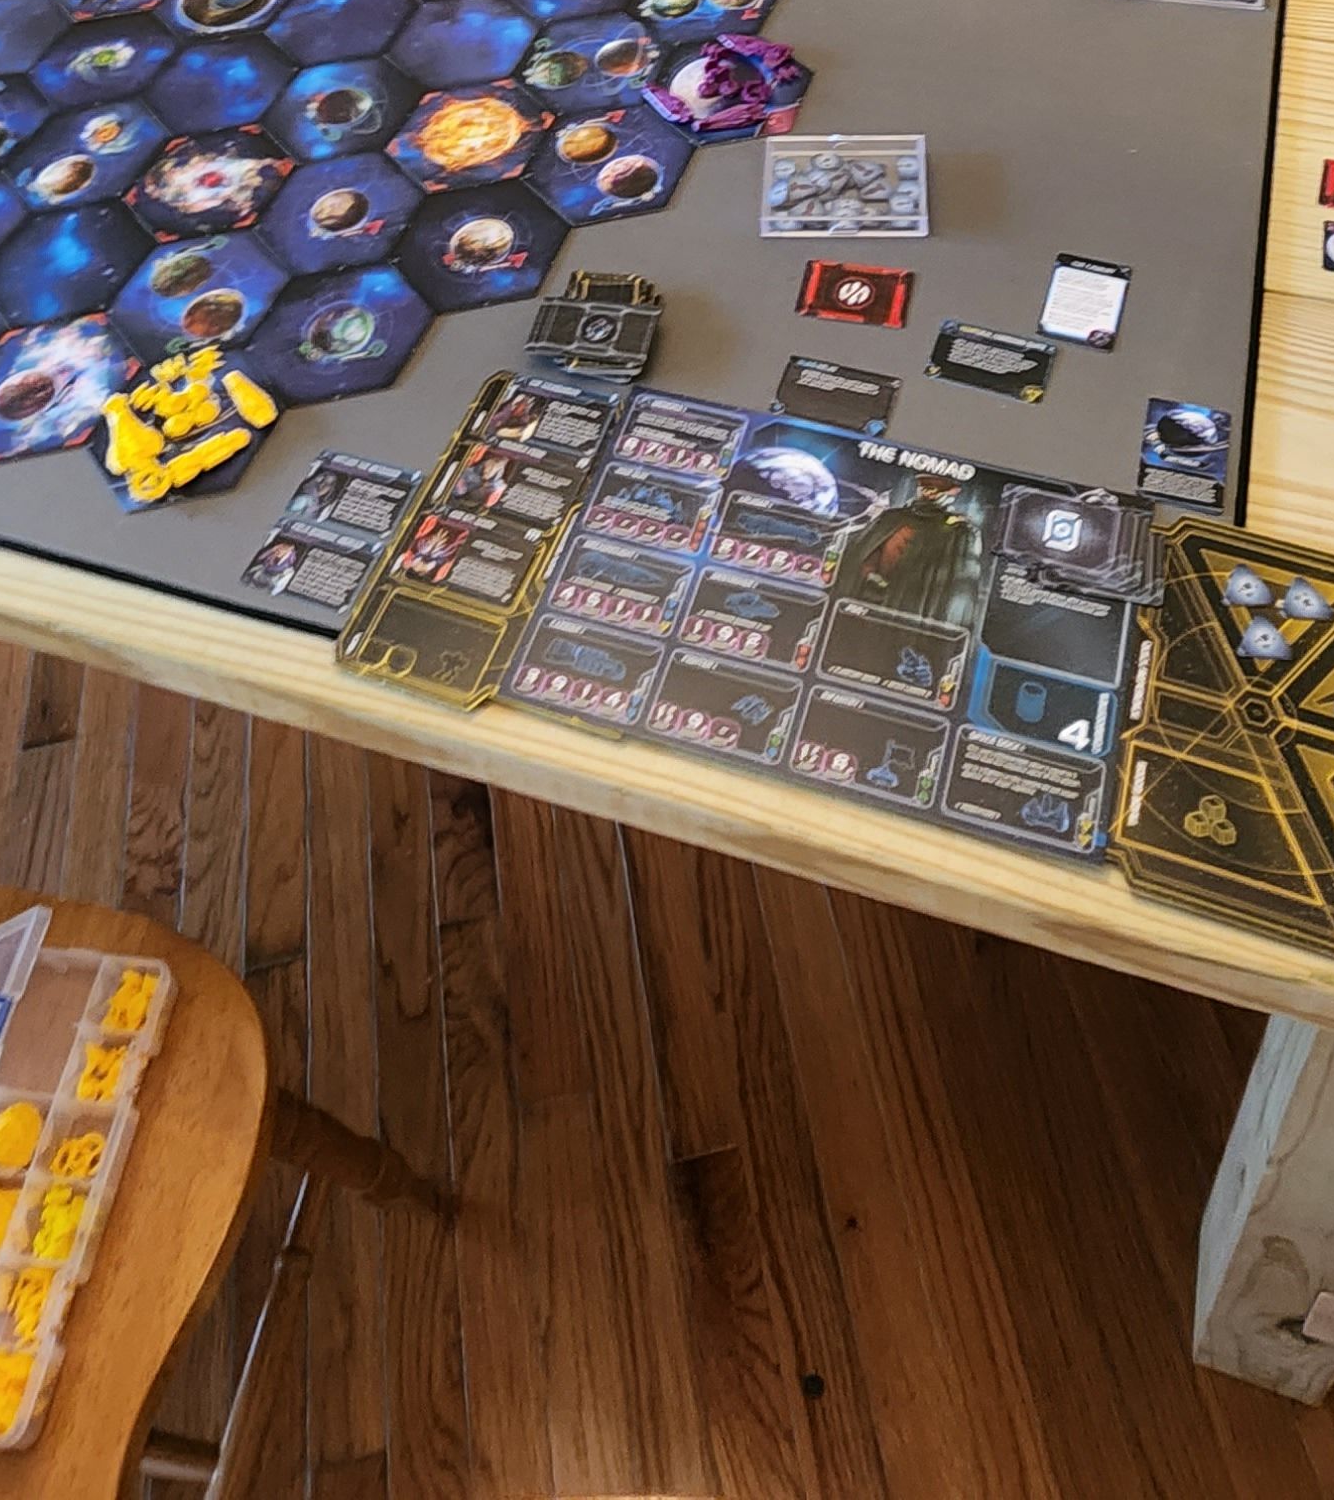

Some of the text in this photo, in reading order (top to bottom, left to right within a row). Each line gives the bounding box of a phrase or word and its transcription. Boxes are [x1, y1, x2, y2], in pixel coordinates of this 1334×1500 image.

[857, 440, 976, 481] THE NOMAD
[1057, 719, 1091, 751] 4
